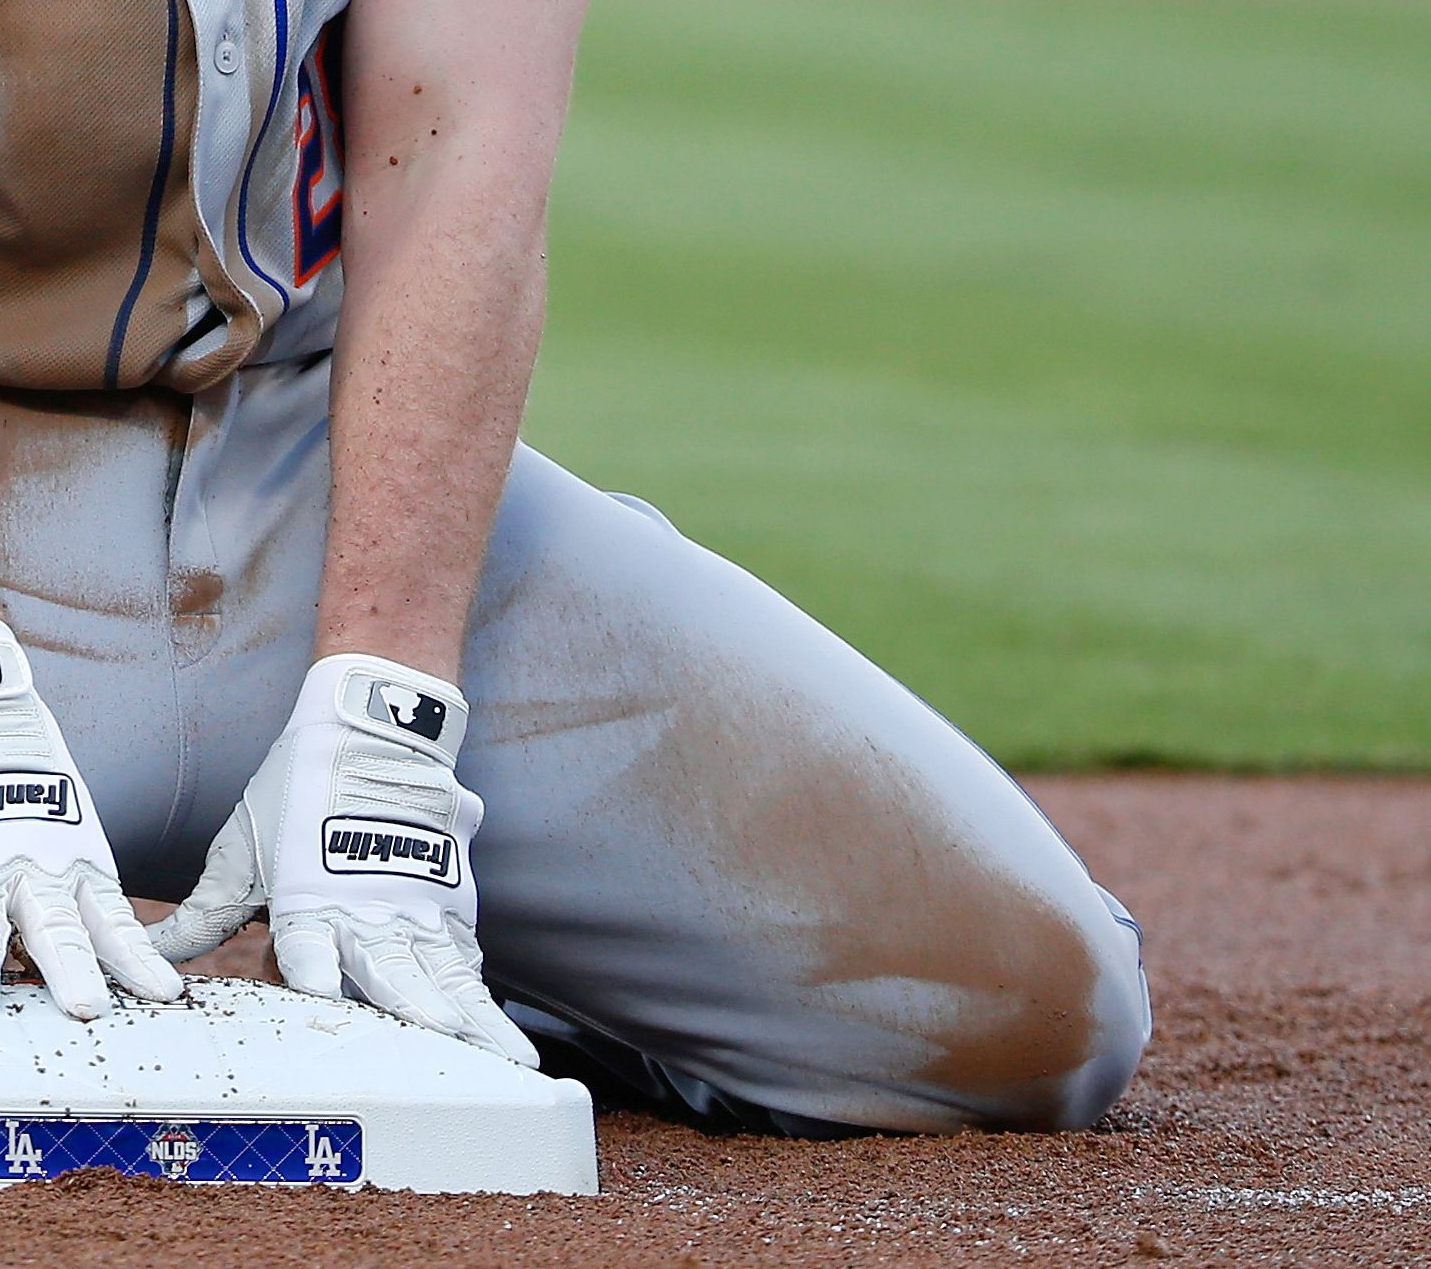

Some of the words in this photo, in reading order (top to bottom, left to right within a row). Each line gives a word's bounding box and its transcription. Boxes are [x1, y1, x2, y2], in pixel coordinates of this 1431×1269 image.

[293, 30, 345, 288] 2
[4, 1120, 43, 1174] LA
[151, 1141, 198, 1160] NLDS
[304, 1124, 342, 1177] LA
